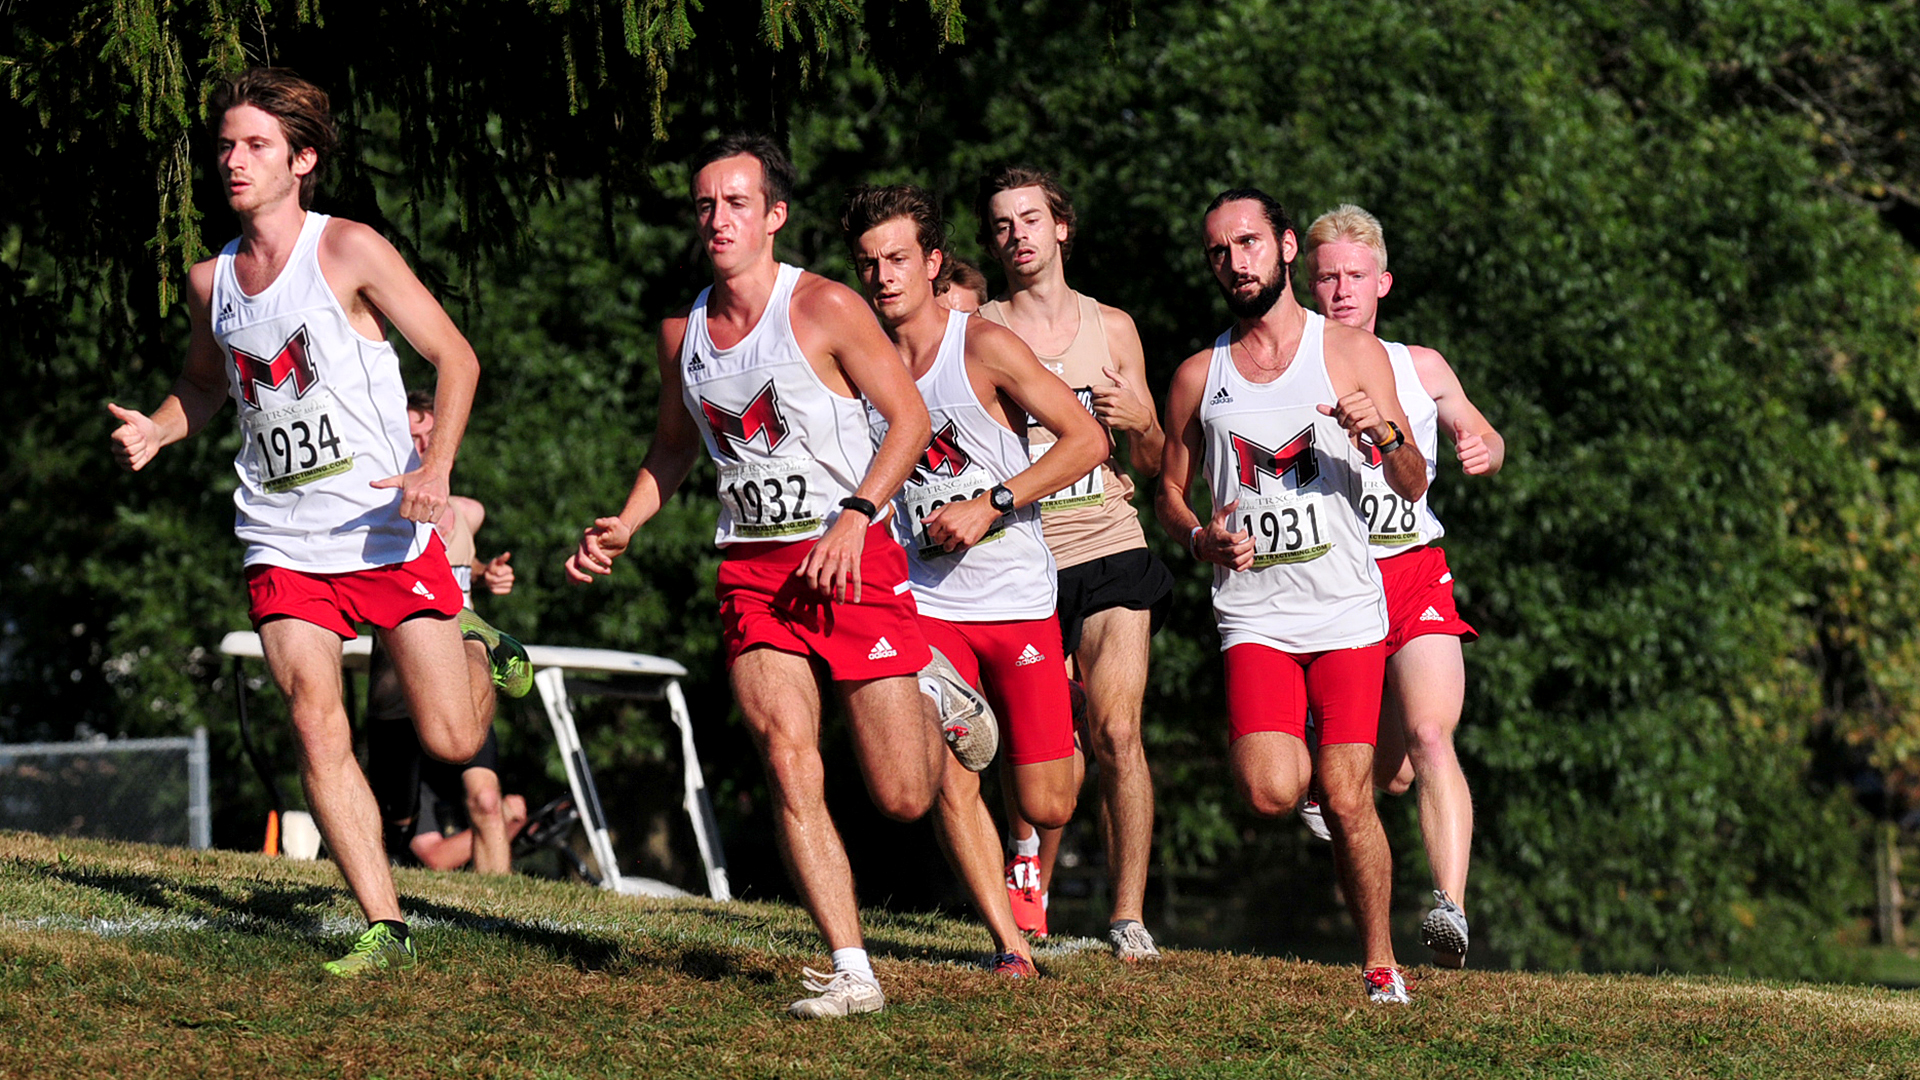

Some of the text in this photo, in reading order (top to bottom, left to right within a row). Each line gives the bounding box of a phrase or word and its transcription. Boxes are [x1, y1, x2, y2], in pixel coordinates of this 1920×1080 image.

[228, 322, 319, 411] M
[264, 399, 302, 421] TRXC
[699, 377, 790, 462] M
[257, 413, 340, 479] 1934
[1229, 422, 1319, 496] M
[727, 474, 811, 524] 1932
[1255, 492, 1294, 506] TRXC
[1243, 503, 1320, 554] 1931
[868, 649, 898, 661] adidas
[1015, 654, 1046, 667] adidas
